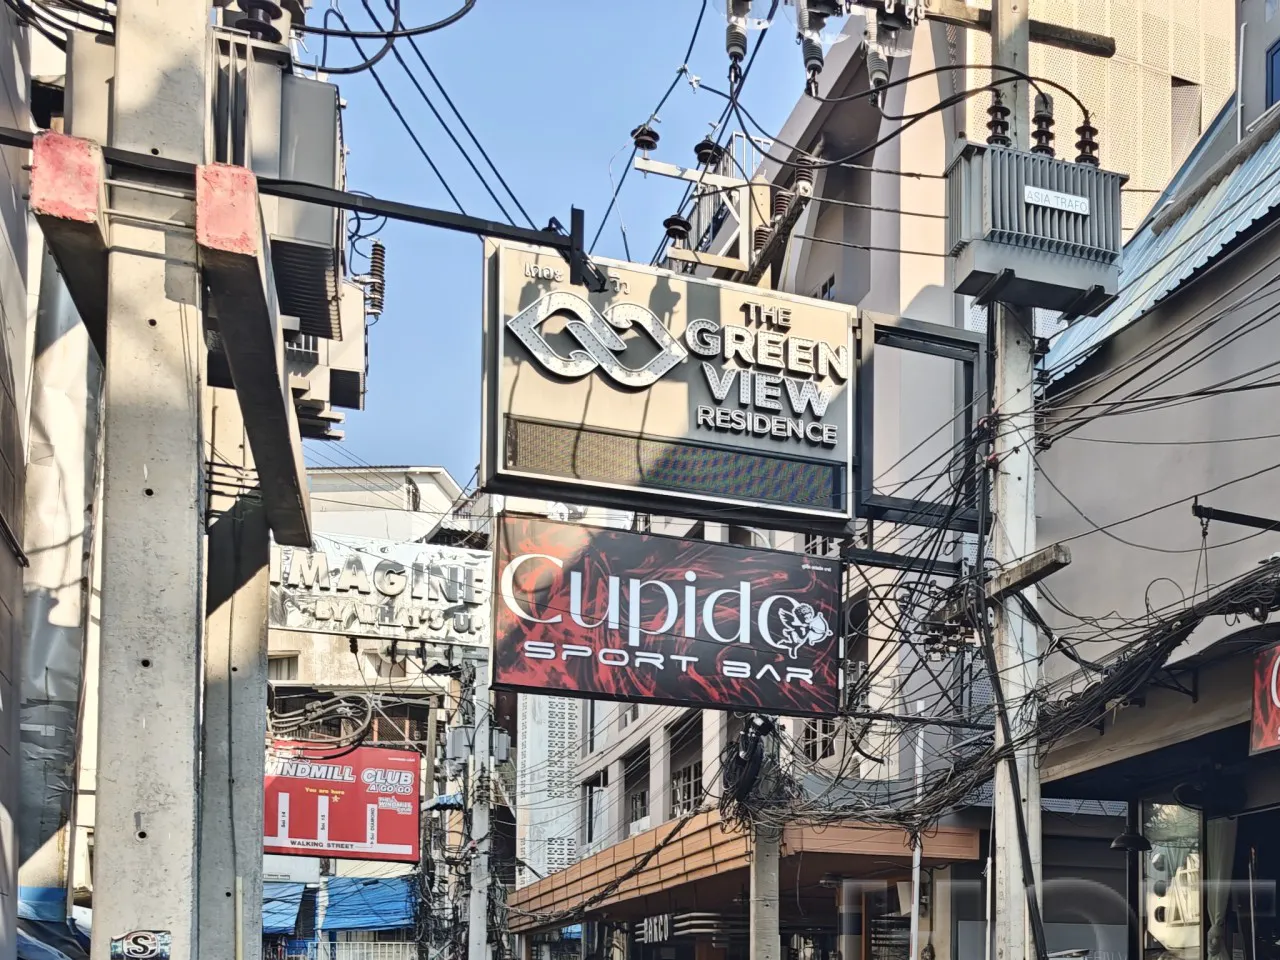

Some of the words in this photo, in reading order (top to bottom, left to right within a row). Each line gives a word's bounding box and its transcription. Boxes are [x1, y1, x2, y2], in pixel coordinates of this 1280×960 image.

[1026, 190, 1051, 205] ASIA
[1054, 195, 1089, 213] TRAFO
[744, 302, 793, 329] THE
[685, 319, 849, 382] GREEN
[701, 361, 835, 419] VIEW
[697, 405, 839, 446] RESIDENCE
[270, 546, 485, 606] IMAGINE
[314, 598, 346, 622] BY
[500, 553, 812, 652] Cupido
[524, 640, 699, 673] SPORT
[722, 660, 814, 685] BAR
[264, 760, 356, 782] WINDMILL
[362, 768, 414, 785] CLUB
[304, 786, 317, 794] You
[330, 788, 345, 796] here
[290, 839, 324, 848] WALKING
[326, 842, 354, 850] STREET
[643, 913, 669, 944] BARCO
